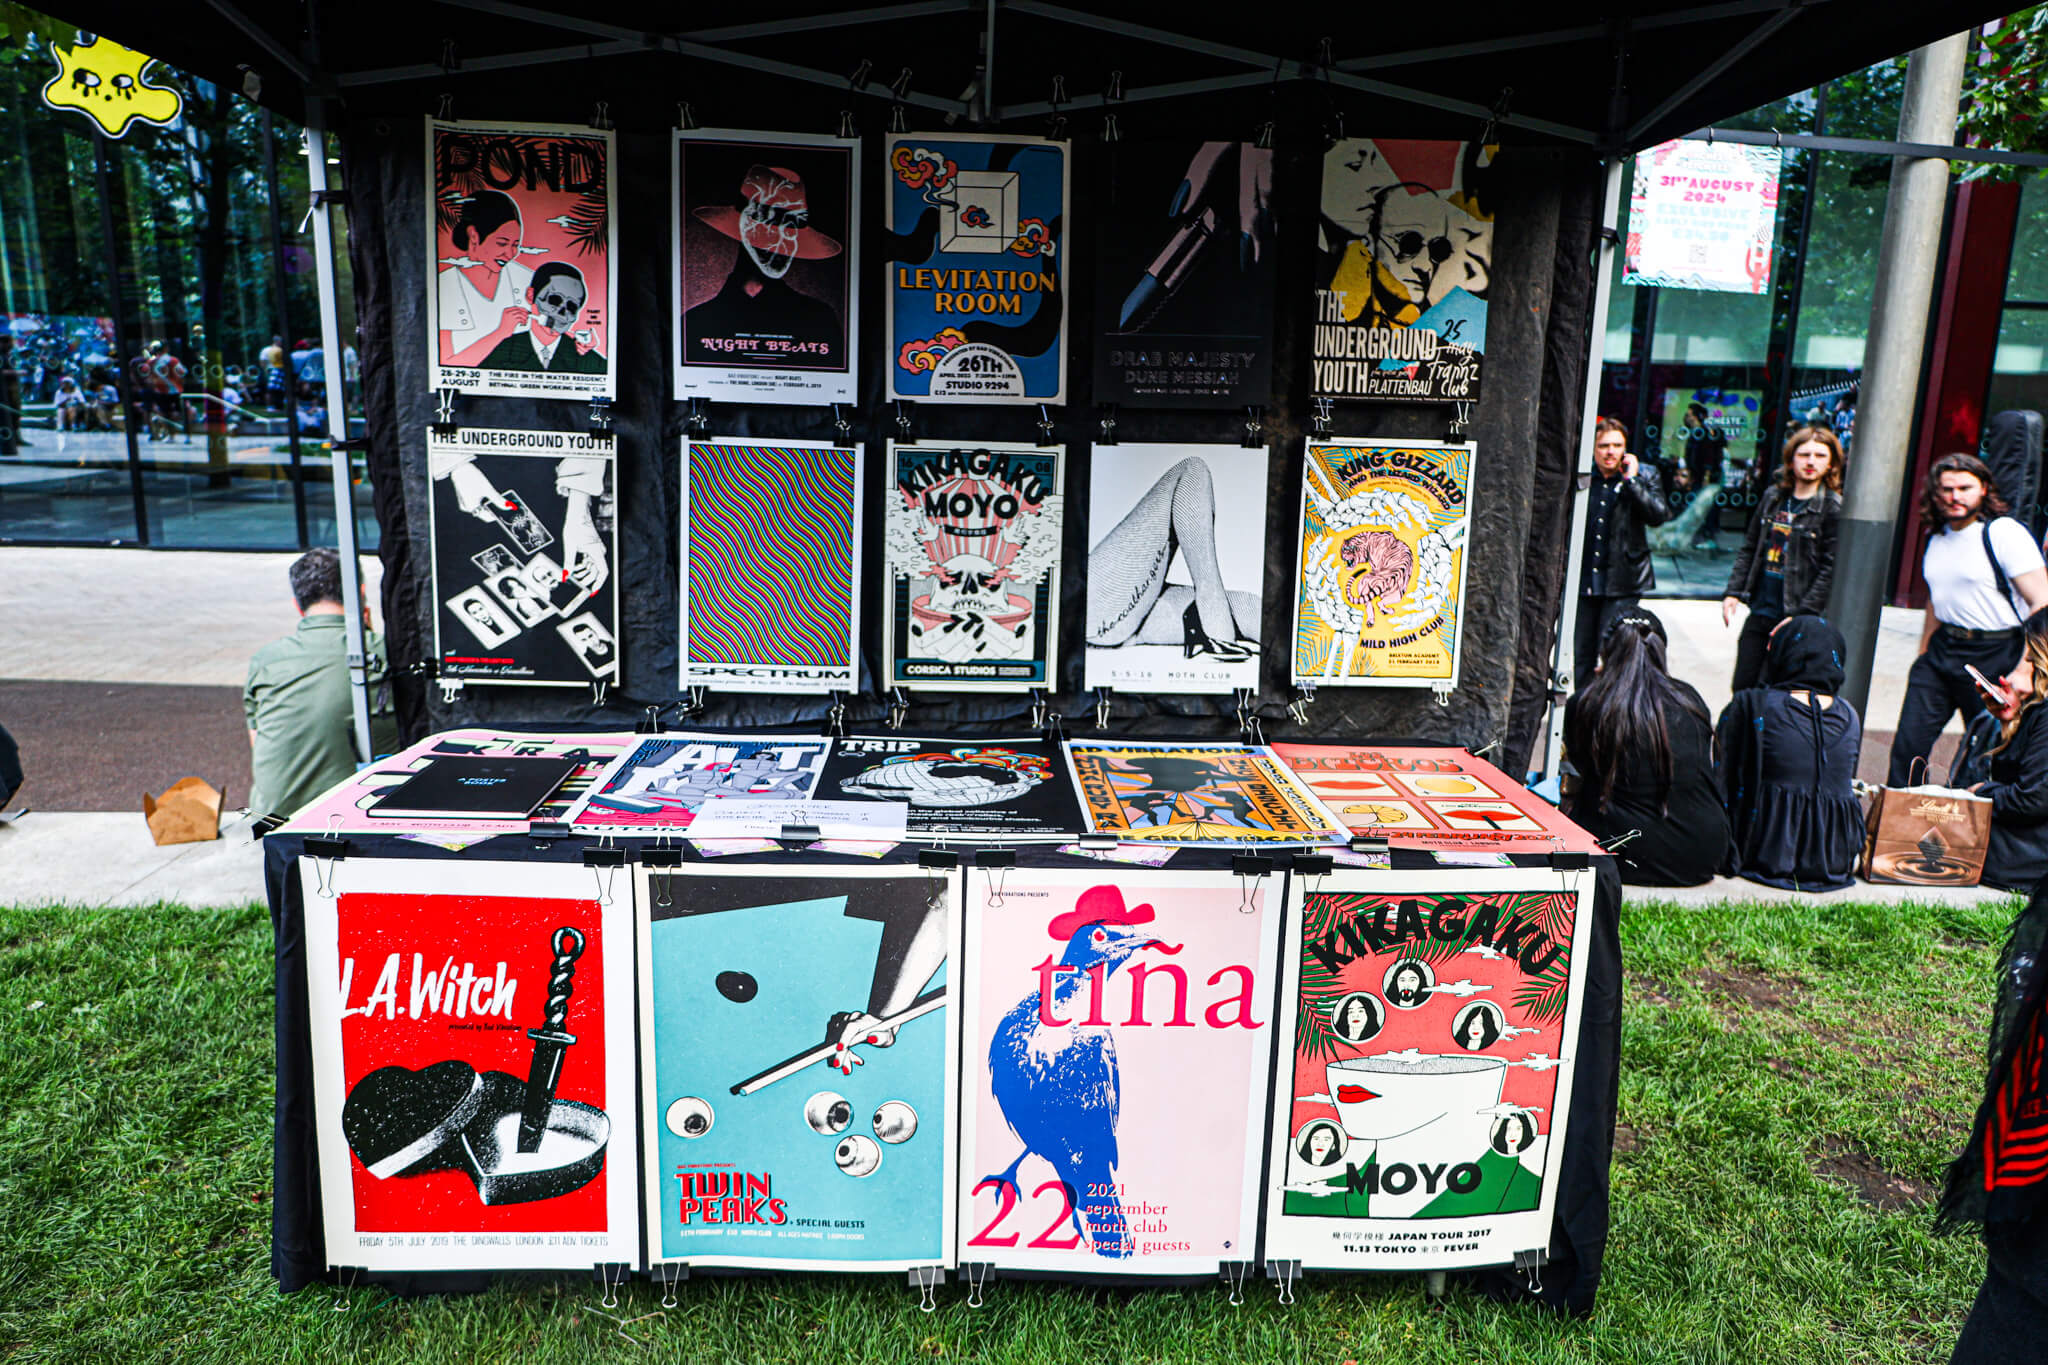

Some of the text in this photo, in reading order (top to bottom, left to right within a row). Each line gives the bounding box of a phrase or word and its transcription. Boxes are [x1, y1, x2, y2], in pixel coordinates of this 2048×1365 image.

[440, 136, 600, 192] POND
[1688, 177, 1755, 193] AUGUST
[1682, 191, 1726, 203] 2024
[899, 268, 1056, 292] LEVITATION
[935, 292, 1022, 314] ROOM
[1315, 289, 1347, 323] THE
[1441, 318, 1467, 340] 25
[701, 337, 830, 355] NIGHT BEATS
[1313, 324, 1438, 361] UNDERGROUND
[957, 354, 1003, 374] 26TH
[1110, 351, 1256, 369] DRAB MAJESTY
[441, 378, 480, 387] AUGUST
[945, 381, 1010, 390] STUDIO 9294
[1170, 371, 1240, 385] MESSIAH
[1313, 360, 1369, 394] YOUTH
[1368, 379, 1433, 395] PLATTENBAU
[431, 430, 614, 451] THE UNDERGROUND YOUTH
[898, 448, 1050, 506] KIKAGAKU
[1336, 451, 1385, 483] KING
[1390, 451, 1465, 505] GIZZARD
[1349, 473, 1368, 488] AND
[1370, 469, 1387, 478] THE
[1388, 469, 1421, 484] LIZARD
[1422, 479, 1450, 511] WIZARD
[925, 492, 1019, 519] MOYO
[1359, 615, 1446, 649] MILD HIGH CLUB
[687, 666, 851, 679] SPECTRUM
[907, 665, 952, 675] CORSICA
[953, 665, 997, 676] STUDIOS
[1203, 672, 1232, 680] CLUB
[840, 739, 921, 753] TRIP
[1107, 746, 1255, 754] VIBRATIONS
[1248, 784, 1299, 830] BISCUIT
[1308, 899, 1563, 975] KIKAGAKU
[338, 952, 518, 1021] L.A. Witch
[674, 1171, 771, 1199] TWIN
[1345, 1162, 1483, 1195] MOYO
[1086, 1183, 1126, 1198] 2021
[678, 1197, 788, 1226] PEAKS
[967, 1178, 1081, 1250] 22
[1085, 1201, 1168, 1219] september
[795, 1218, 865, 1229] SPECIAL GUESTS
[1085, 1218, 1168, 1234] moth club
[359, 1235, 385, 1247] FRIDAY
[388, 1236, 404, 1247] 5TH
[408, 1236, 426, 1247] JULY
[453, 1235, 467, 1247] THE
[515, 1235, 544, 1247] LONDON
[1387, 1231, 1428, 1241] JAPAN
[1430, 1230, 1464, 1240] TOUR
[1466, 1228, 1493, 1239] 2017
[1084, 1236, 1191, 1255] special guests
[1342, 1244, 1371, 1254] 11.13
[1373, 1245, 1416, 1254] TOKYO
[1442, 1243, 1480, 1254] FEVER
